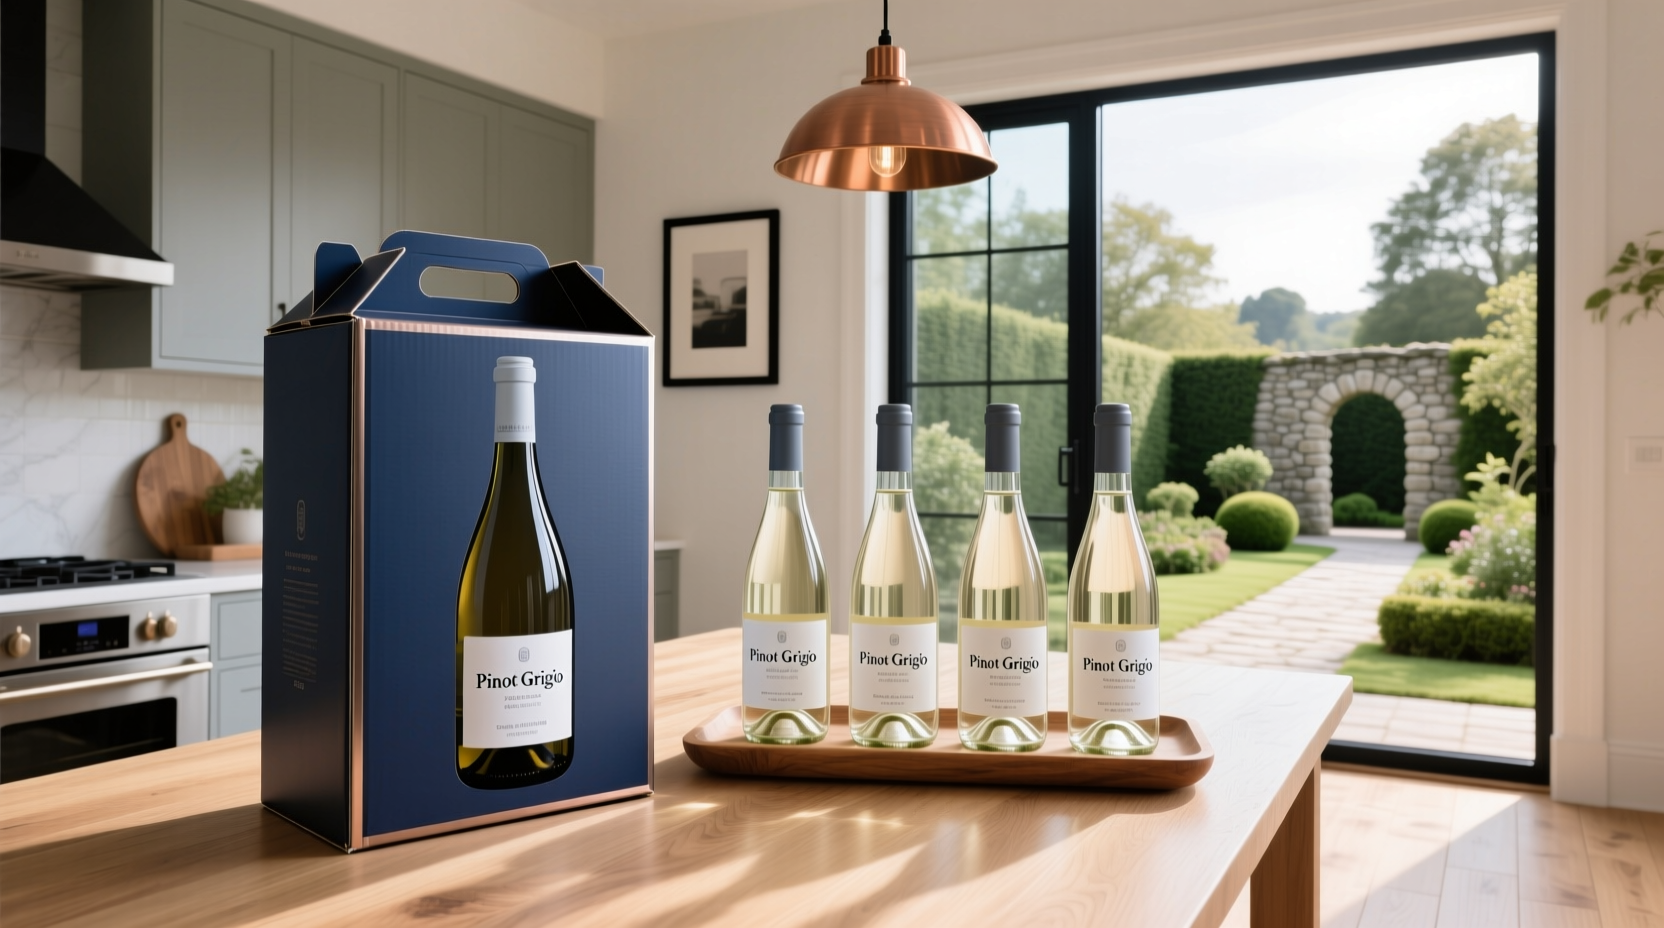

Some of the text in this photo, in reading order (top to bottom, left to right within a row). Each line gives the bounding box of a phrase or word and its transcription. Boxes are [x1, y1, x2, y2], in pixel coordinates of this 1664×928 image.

[750, 648, 778, 663] Pinot
[860, 651, 889, 666] Pinot
[970, 654, 999, 669] Pinot
[1083, 657, 1115, 672] Pinot
[476, 672, 517, 689] Pinot
